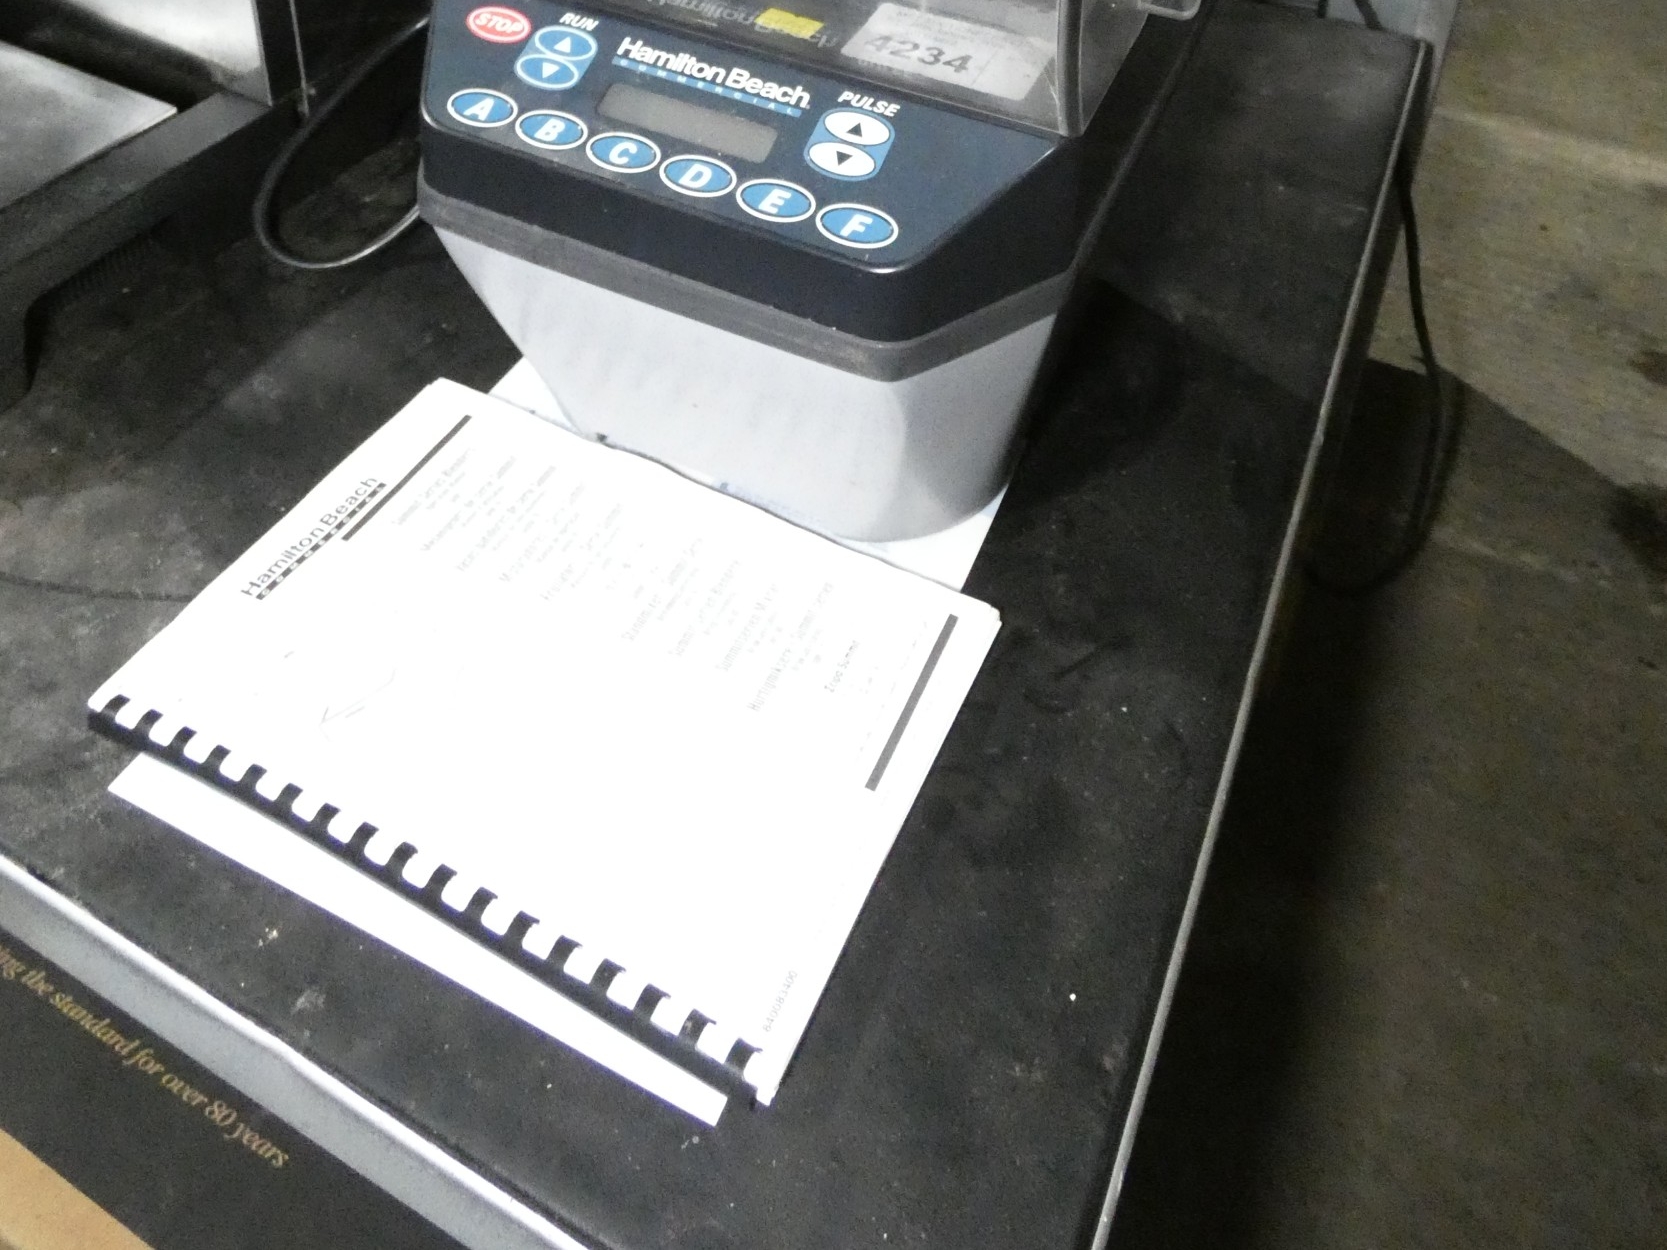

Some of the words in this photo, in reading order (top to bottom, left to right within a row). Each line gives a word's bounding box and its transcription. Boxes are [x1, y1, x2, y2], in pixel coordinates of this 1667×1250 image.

[474, 12, 525, 34] STOP
[559, 12, 599, 31] RUN
[865, 35, 973, 74] 4234
[617, 36, 726, 83] Hamilton
[726, 68, 811, 109] Beach
[619, 59, 795, 116] COMMERCIAL
[463, 98, 494, 121] A
[838, 91, 900, 117] PULSE
[534, 119, 566, 142] B
[608, 142, 638, 164] C
[678, 163, 712, 187] D
[758, 190, 791, 214] E
[840, 213, 873, 237] F
[241, 526, 325, 596] Hamilton
[320, 477, 378, 526] Beach
[21, 969, 54, 997] the
[50, 990, 141, 1056] standard
[122, 1047, 165, 1075] for
[162, 1074, 208, 1106] over
[205, 1100, 238, 1127] 80
[223, 1122, 289, 1169] years
